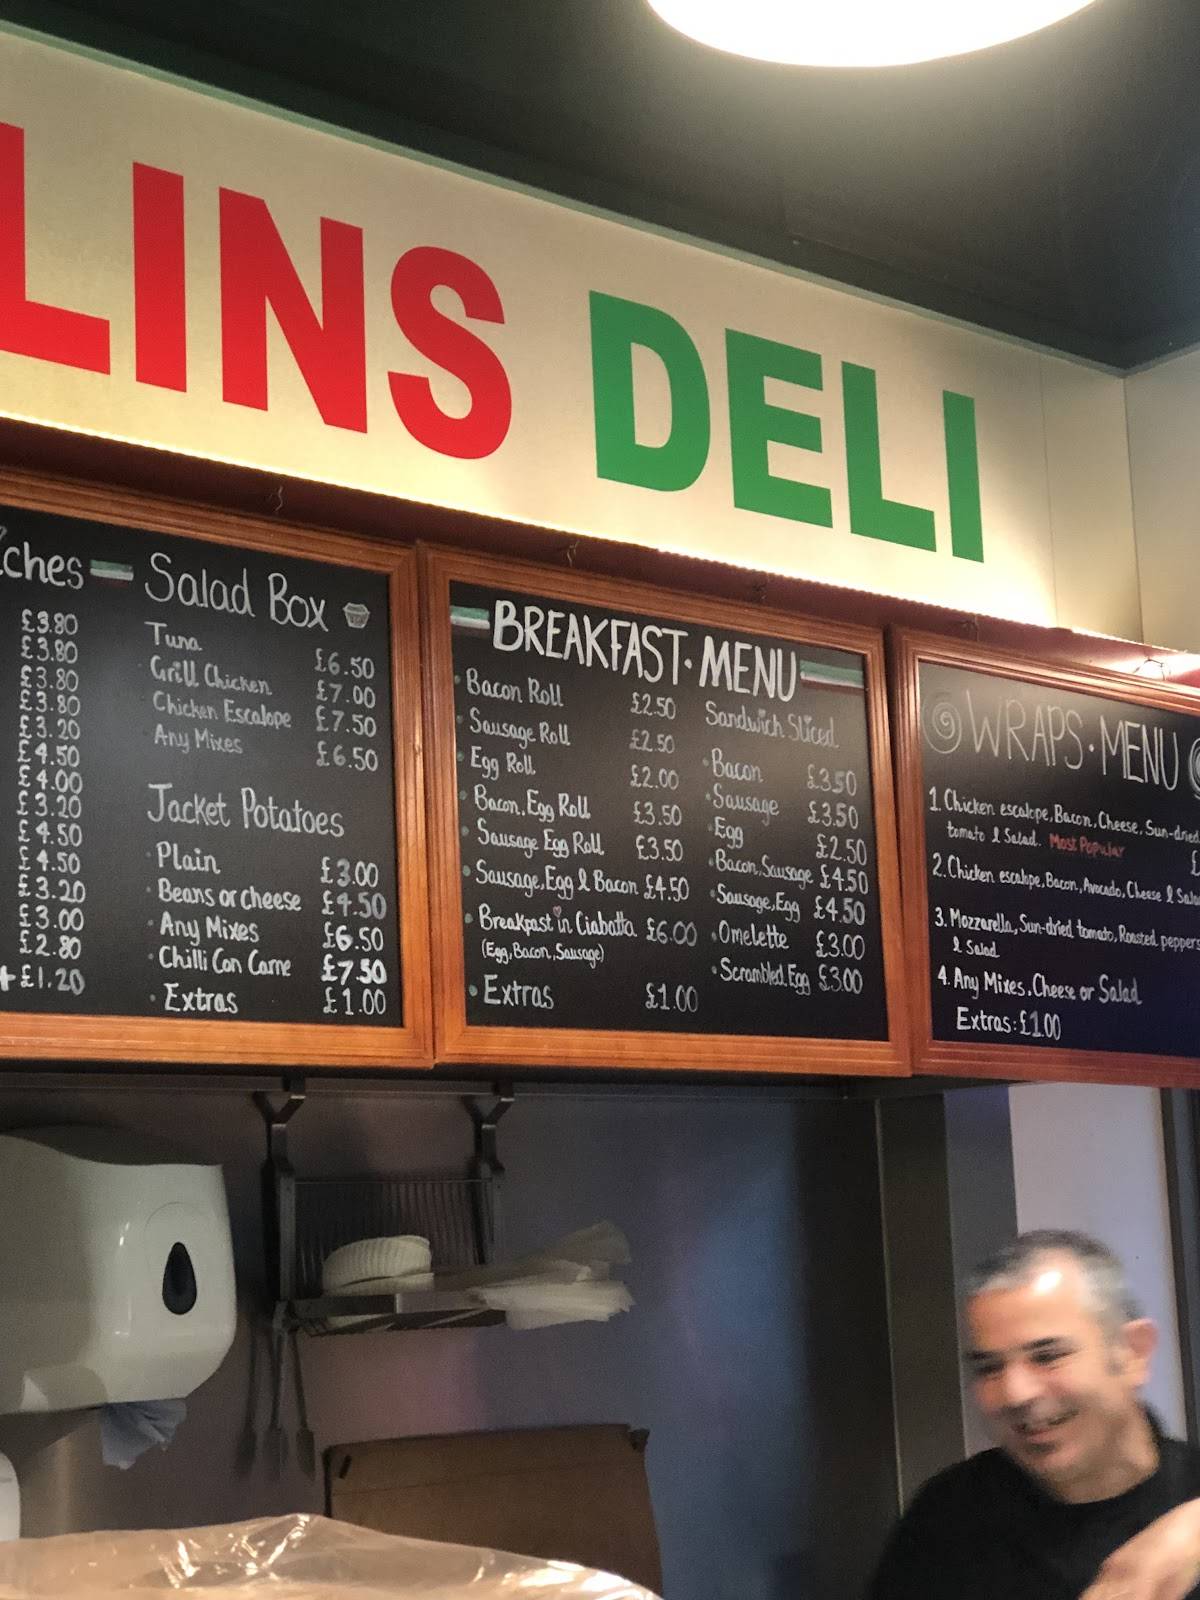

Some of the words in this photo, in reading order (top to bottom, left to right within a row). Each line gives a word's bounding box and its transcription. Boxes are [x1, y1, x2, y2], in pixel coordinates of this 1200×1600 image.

[589, 289, 984, 563] DELI
[0, 541, 84, 589] ches
[145, 552, 256, 617] Salad
[268, 572, 329, 632] Box
[22, 609, 78, 635] £3.80
[21, 635, 78, 664] £3.80
[144, 621, 203, 651] Tuna
[314, 648, 375, 679] £6.50
[492, 599, 688, 686] BREAKFAST
[699, 636, 796, 702] MENU
[20, 665, 79, 692] £3.80
[150, 655, 199, 687] Grill
[204, 663, 273, 696] Chicken
[315, 680, 376, 709] £7.00
[466, 667, 523, 703] Bacon
[528, 677, 564, 707] Roll
[630, 692, 676, 720] £2.50
[20, 690, 80, 716] £3.80
[152, 690, 218, 720] Chicken
[223, 699, 292, 729] Escalope
[316, 705, 377, 738] £7.50
[19, 715, 80, 740] £3.20
[469, 707, 536, 749] Sausage
[629, 729, 675, 753] £2.50
[705, 701, 785, 738] Sandwich
[788, 713, 840, 749] Sliced
[966, 689, 1084, 770] WRAPS
[1099, 715, 1179, 791] MENU
[17, 740, 80, 767] £4.50
[154, 724, 189, 753] Any
[194, 727, 243, 754] Mixes
[316, 740, 378, 772] £6.50
[470, 745, 499, 781] Egg
[629, 764, 679, 790] £2.00
[711, 748, 764, 783] Bacon
[18, 765, 83, 794] £4.00
[17, 790, 81, 818] £3.20
[147, 783, 231, 827] Jacket
[241, 787, 345, 837] Potatoes
[526, 789, 555, 823] Egg
[633, 801, 682, 826] £3.50
[713, 783, 779, 826] Sausage
[807, 801, 858, 829] £3.50
[928, 786, 941, 812] 1.
[944, 789, 996, 816] Chicken
[18, 819, 82, 847] £4.50
[477, 818, 539, 859] Sausage
[543, 829, 569, 858] Egg
[636, 835, 683, 862] £3.50
[714, 816, 744, 849] Egg
[816, 833, 868, 866] £2.50
[947, 821, 985, 843] tomato
[18, 846, 81, 874] £4.50
[156, 841, 221, 875] Plain
[320, 856, 379, 888] £3.00
[762, 855, 814, 890] Sausage
[820, 864, 869, 895] £4.50
[932, 852, 946, 879] 2.
[947, 855, 995, 884] Chicken
[1127, 881, 1162, 902] Cheese
[18, 874, 86, 903] £3.20
[157, 877, 215, 907] Beans
[219, 889, 236, 907] or
[240, 885, 302, 911] cheese
[545, 865, 574, 900] Egg
[593, 869, 639, 895] Bacon
[644, 874, 690, 902] £4.50
[19, 903, 84, 932] £3.00
[575, 910, 637, 937] Ciabatta
[646, 918, 698, 947] £6.00
[776, 892, 800, 923] Egg
[814, 895, 865, 926] £4.50
[934, 907, 947, 928] 3.
[1019, 914, 1074, 939] Sun-dried
[1118, 925, 1159, 947] Roasted
[19, 929, 81, 959] £2.80
[160, 911, 200, 947] Any
[206, 914, 260, 943] Mixes
[322, 921, 384, 951] £6.50
[718, 920, 789, 950] Omelette
[816, 930, 865, 960] £3.00
[966, 940, 1000, 959] Salad
[158, 945, 208, 971] Chilli
[248, 949, 292, 977] Carne
[320, 954, 387, 985] £7.50
[787, 964, 811, 995] Egg
[818, 964, 863, 994] £3.00
[937, 965, 950, 986] 4.
[953, 966, 979, 999] Any
[1032, 973, 1076, 1000] Cheese
[1079, 985, 1095, 999] or
[1099, 974, 1142, 1004] Salad
[163, 982, 239, 1014] Extras
[322, 986, 386, 1016] £1.00
[483, 974, 554, 1009] Extras
[645, 982, 698, 1013] £1.00
[1019, 1009, 1061, 1041] £1.00
